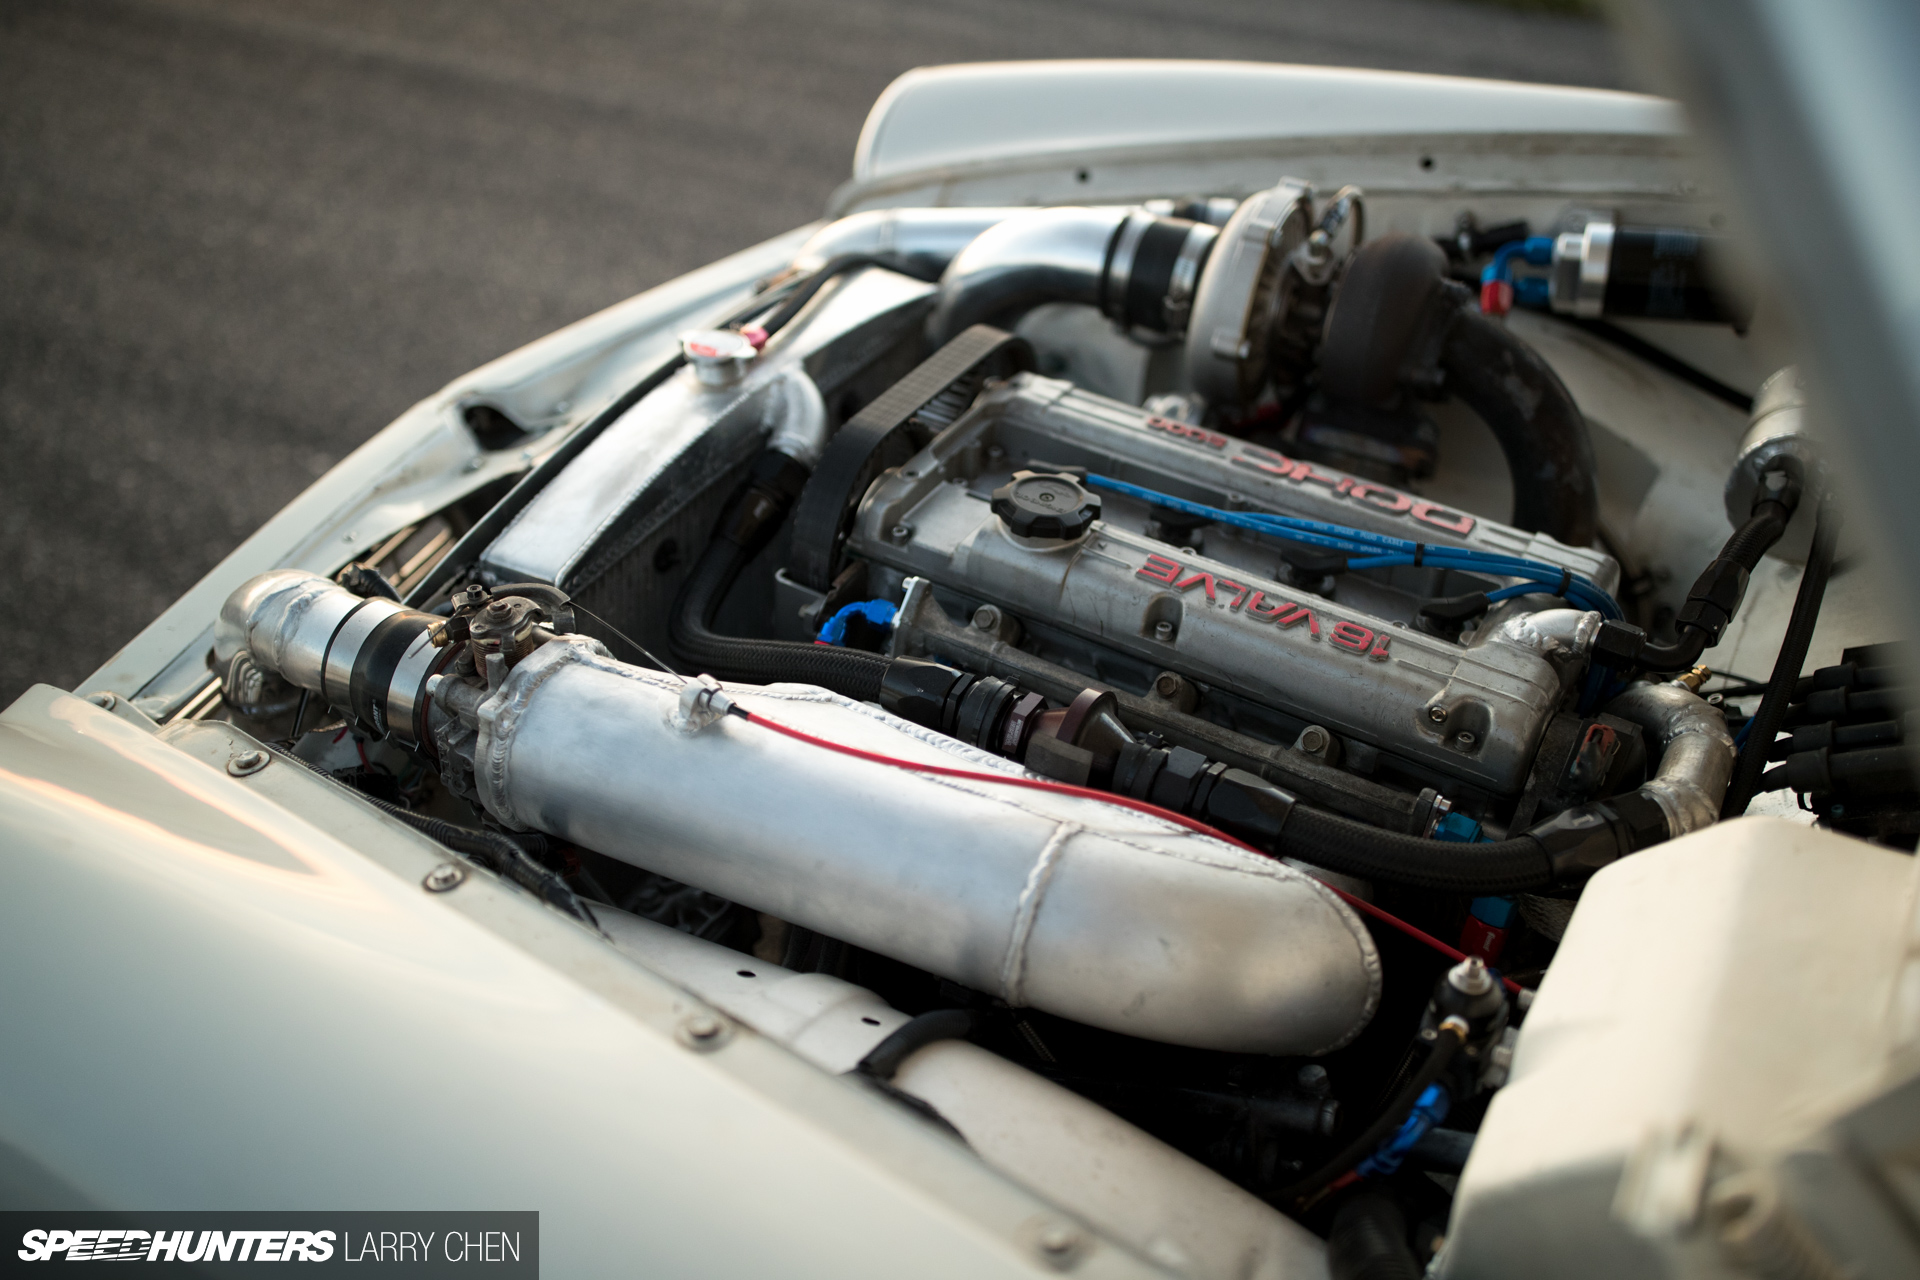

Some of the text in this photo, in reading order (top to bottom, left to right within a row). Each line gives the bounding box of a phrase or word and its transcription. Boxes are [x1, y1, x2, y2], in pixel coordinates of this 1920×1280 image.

[1147, 416, 1227, 448] 2000
[1231, 446, 1477, 539] DOHC
[1134, 552, 1391, 662] 16 VALVE
